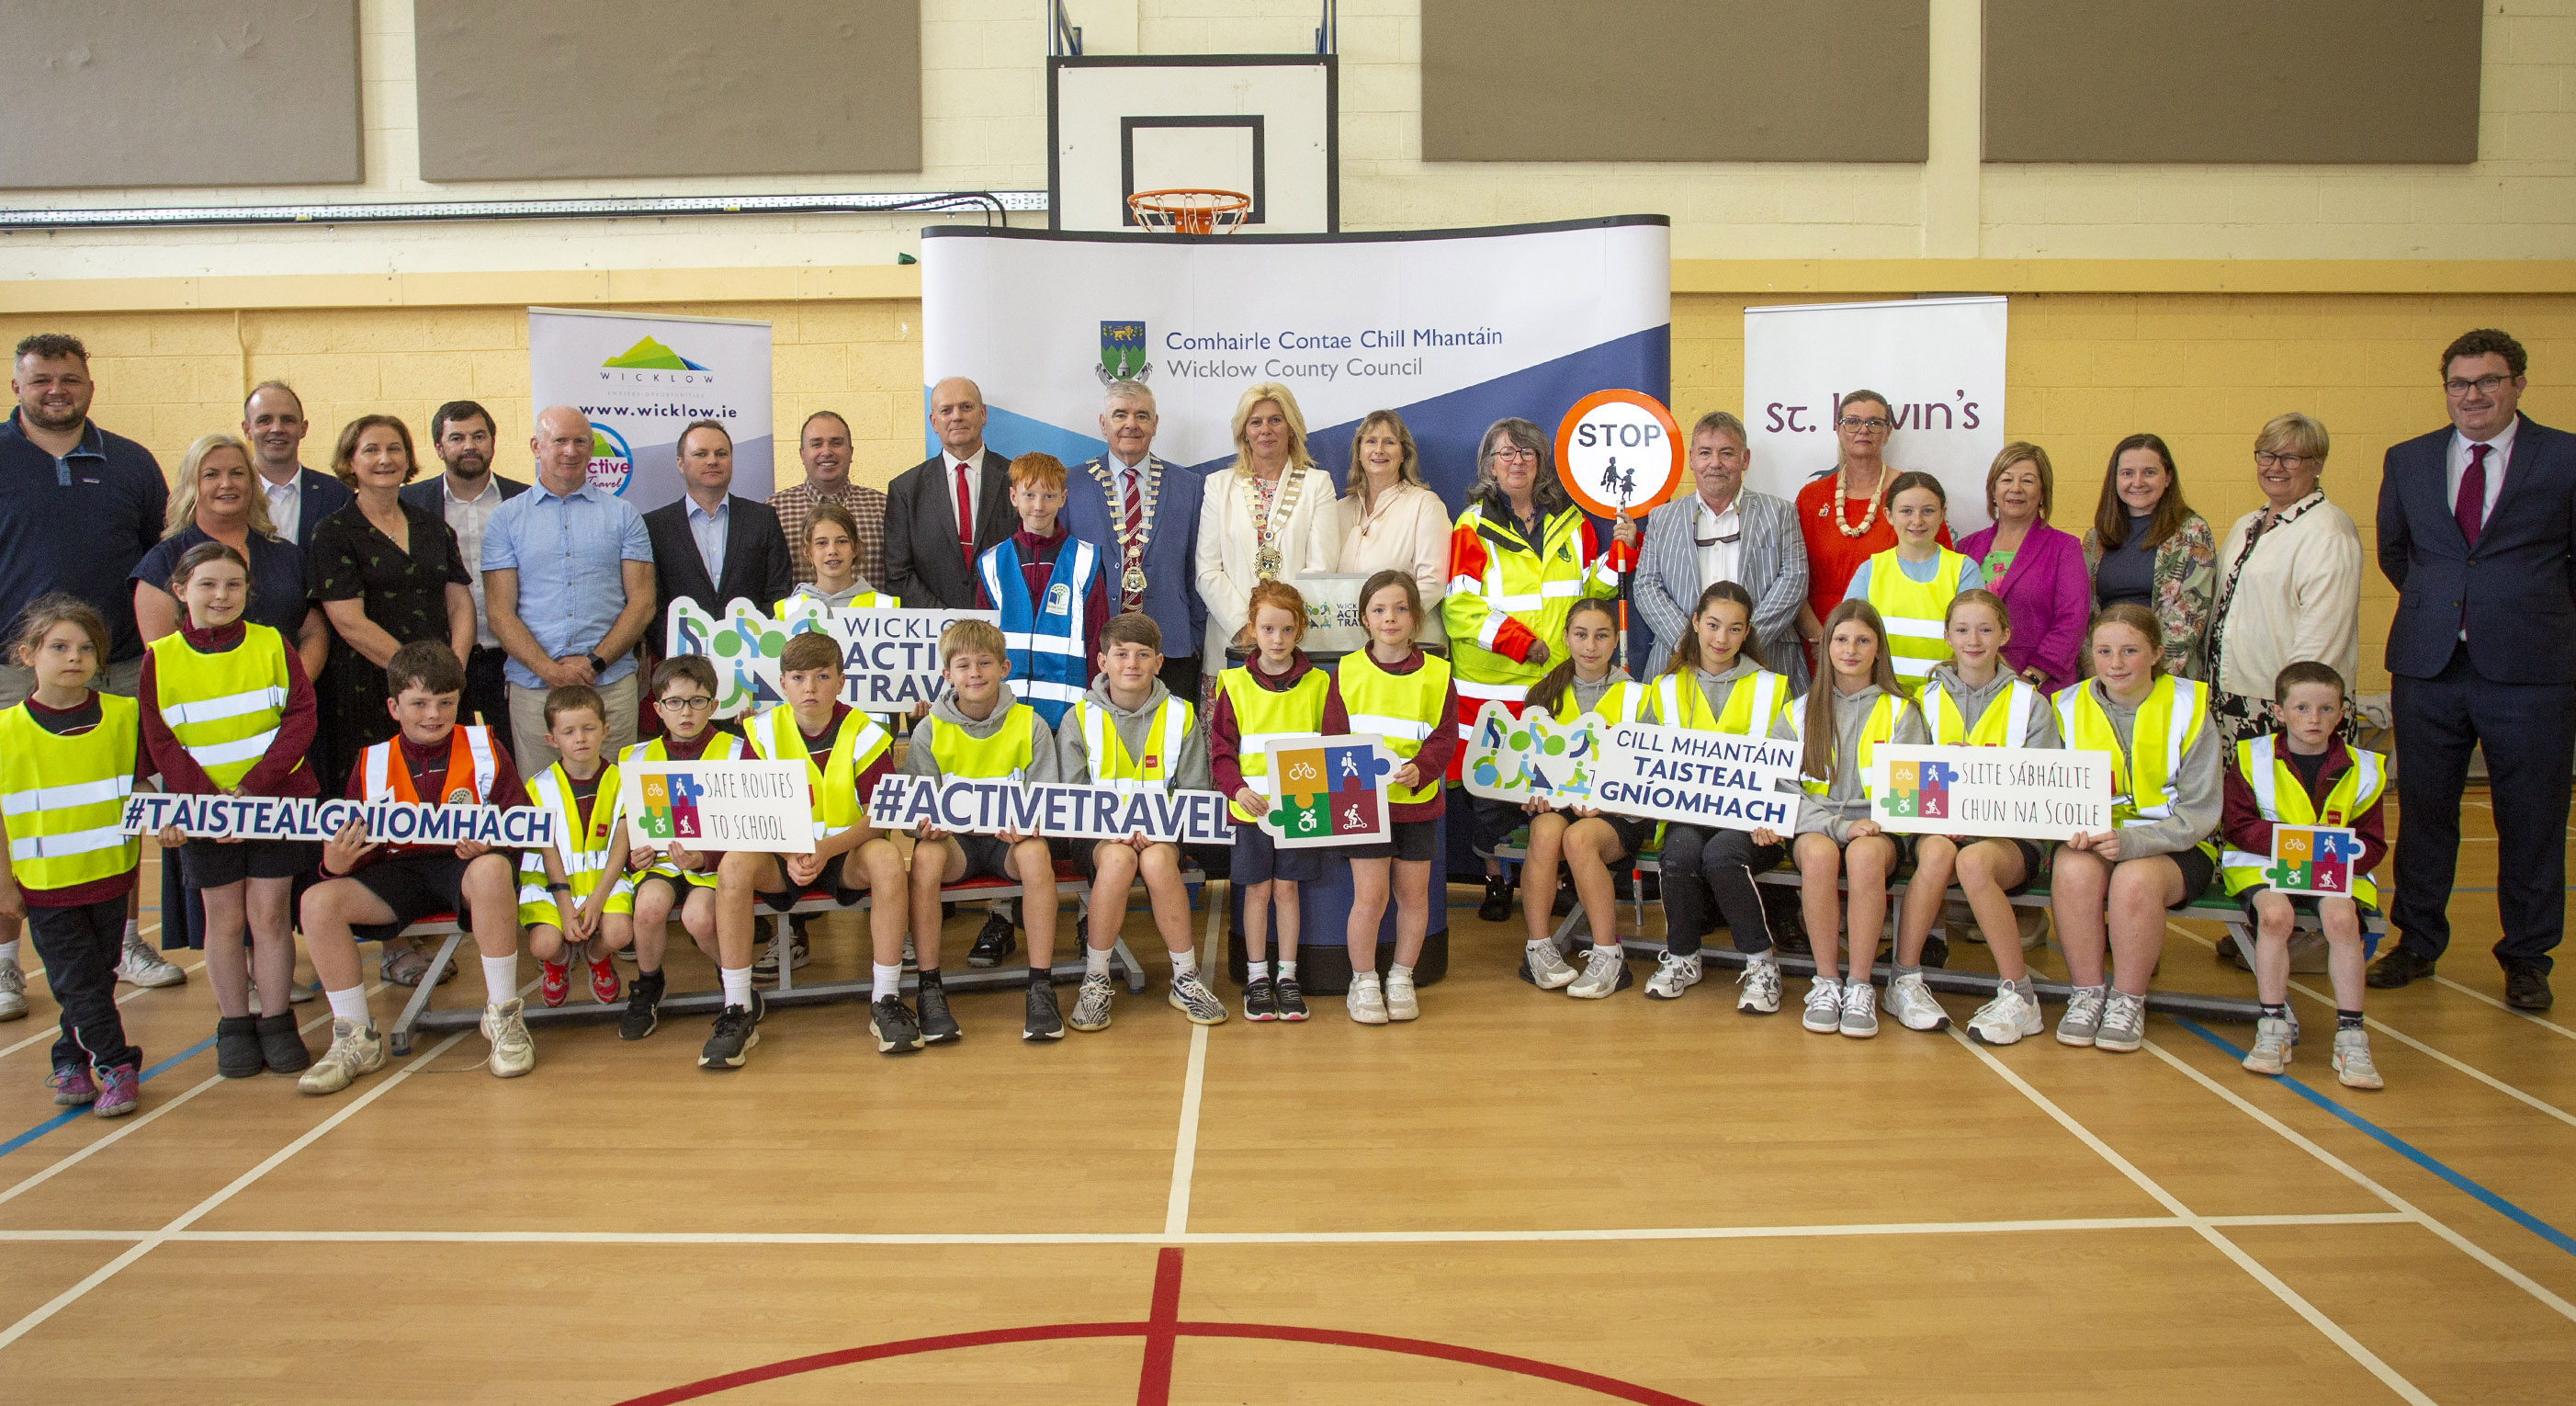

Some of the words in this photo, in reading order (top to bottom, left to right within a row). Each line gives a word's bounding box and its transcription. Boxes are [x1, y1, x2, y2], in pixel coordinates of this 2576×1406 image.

[1166, 332, 1271, 350] Comhairle
[1278, 331, 1351, 349] Contae
[1361, 330, 1405, 348] Chill
[1413, 326, 1503, 347] Mhantáin
[600, 372, 713, 383] WICKLOW
[1167, 359, 1258, 378] Wicklow
[1264, 358, 1339, 382] County
[1346, 357, 1422, 376] Council
[579, 403, 737, 418] www.wicklow.ie
[1578, 423, 1661, 448] STOP
[588, 459, 631, 474] ctive
[588, 475, 623, 488] Travel
[843, 618, 990, 639] WICKL
[1337, 618, 1361, 627] TRA
[844, 642, 935, 670] ACTI
[844, 675, 954, 702] TRAV
[1617, 730, 1664, 752] CILL
[1671, 736, 1794, 768] MHANTÁIN
[1633, 755, 1762, 791] TAISTEAL
[1962, 762, 2002, 785] SLITE
[2009, 761, 2091, 788] SÁBHÁILTE
[705, 773, 737, 798] SAFE
[740, 773, 794, 799] ROUTES
[874, 779, 1232, 839] #ACTIVETRAVEL
[1599, 780, 1786, 823] GNÍOMHACH
[1961, 799, 2005, 822] CHUN
[2015, 800, 2038, 823] NA
[709, 814, 729, 840] TO
[733, 814, 786, 841] SCHOOL
